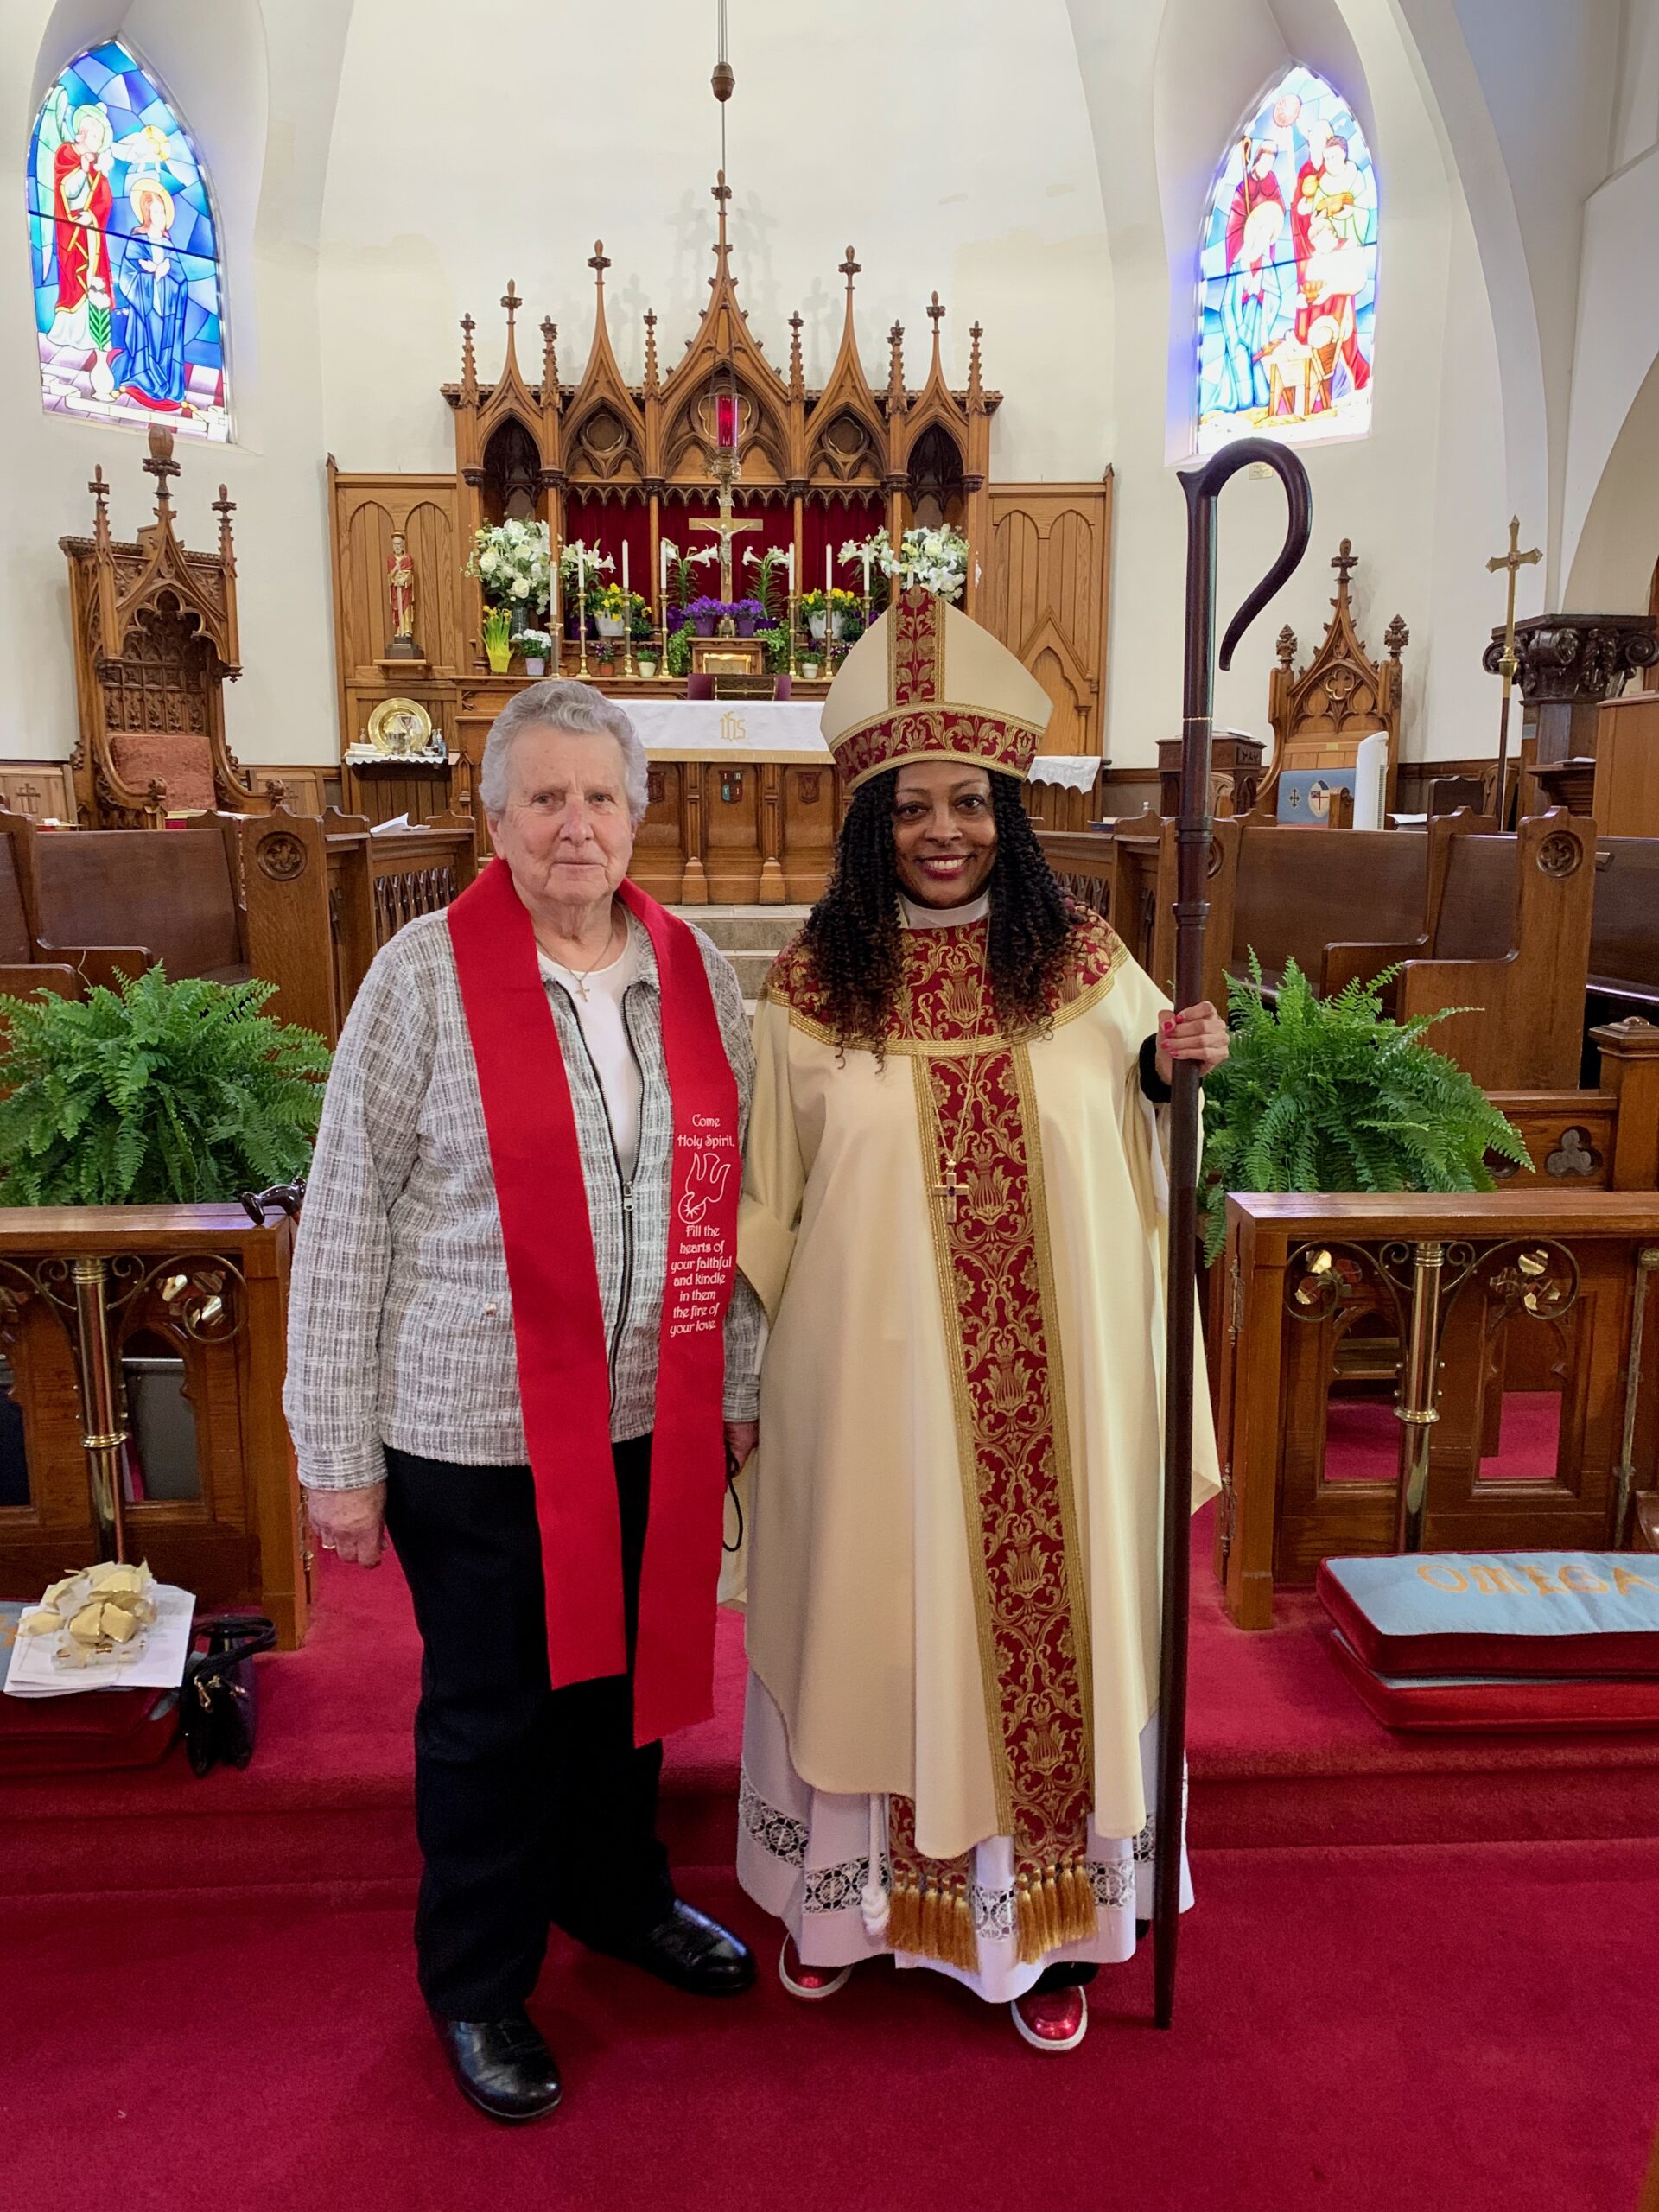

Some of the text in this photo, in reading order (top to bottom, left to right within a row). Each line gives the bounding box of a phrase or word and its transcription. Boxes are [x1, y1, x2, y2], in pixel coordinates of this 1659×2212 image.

[692, 1114, 721, 1128] Come
[677, 1134, 734, 1149] Holy Spirit,
[685, 1224, 721, 1237] Fill the
[680, 1240, 725, 1255] hearts of
[671, 1255, 733, 1274] your faithful
[673, 1272, 726, 1286] and kindle
[680, 1288, 716, 1301] in them
[672, 1302, 721, 1319] the fire of
[670, 1320, 716, 1338] your love
[1417, 1564, 1659, 1596] OMEGA
